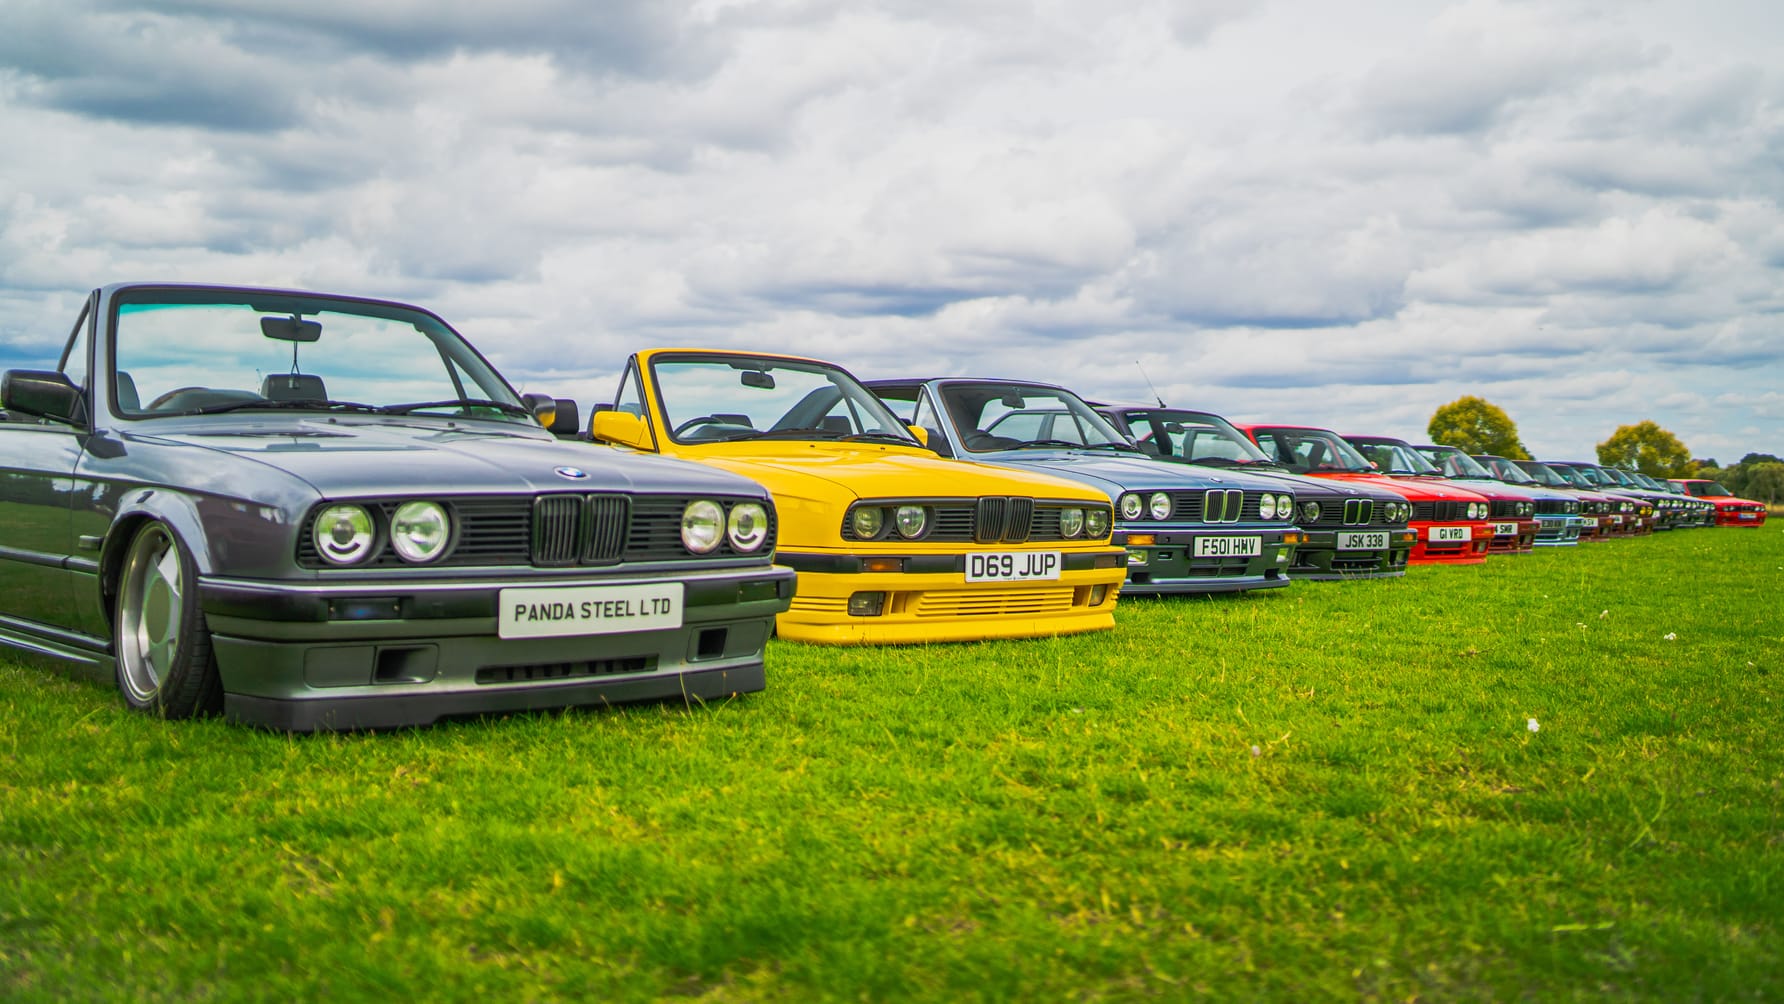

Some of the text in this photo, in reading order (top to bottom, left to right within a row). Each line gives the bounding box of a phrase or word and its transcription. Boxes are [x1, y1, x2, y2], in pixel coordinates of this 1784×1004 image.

[1345, 534, 1384, 548] JSK 338
[1449, 528, 1463, 539] VRD
[1202, 538, 1256, 555] F501 HMV
[971, 553, 1056, 578] D69 JUP
[514, 598, 671, 622] PANDA STEEL LTD
